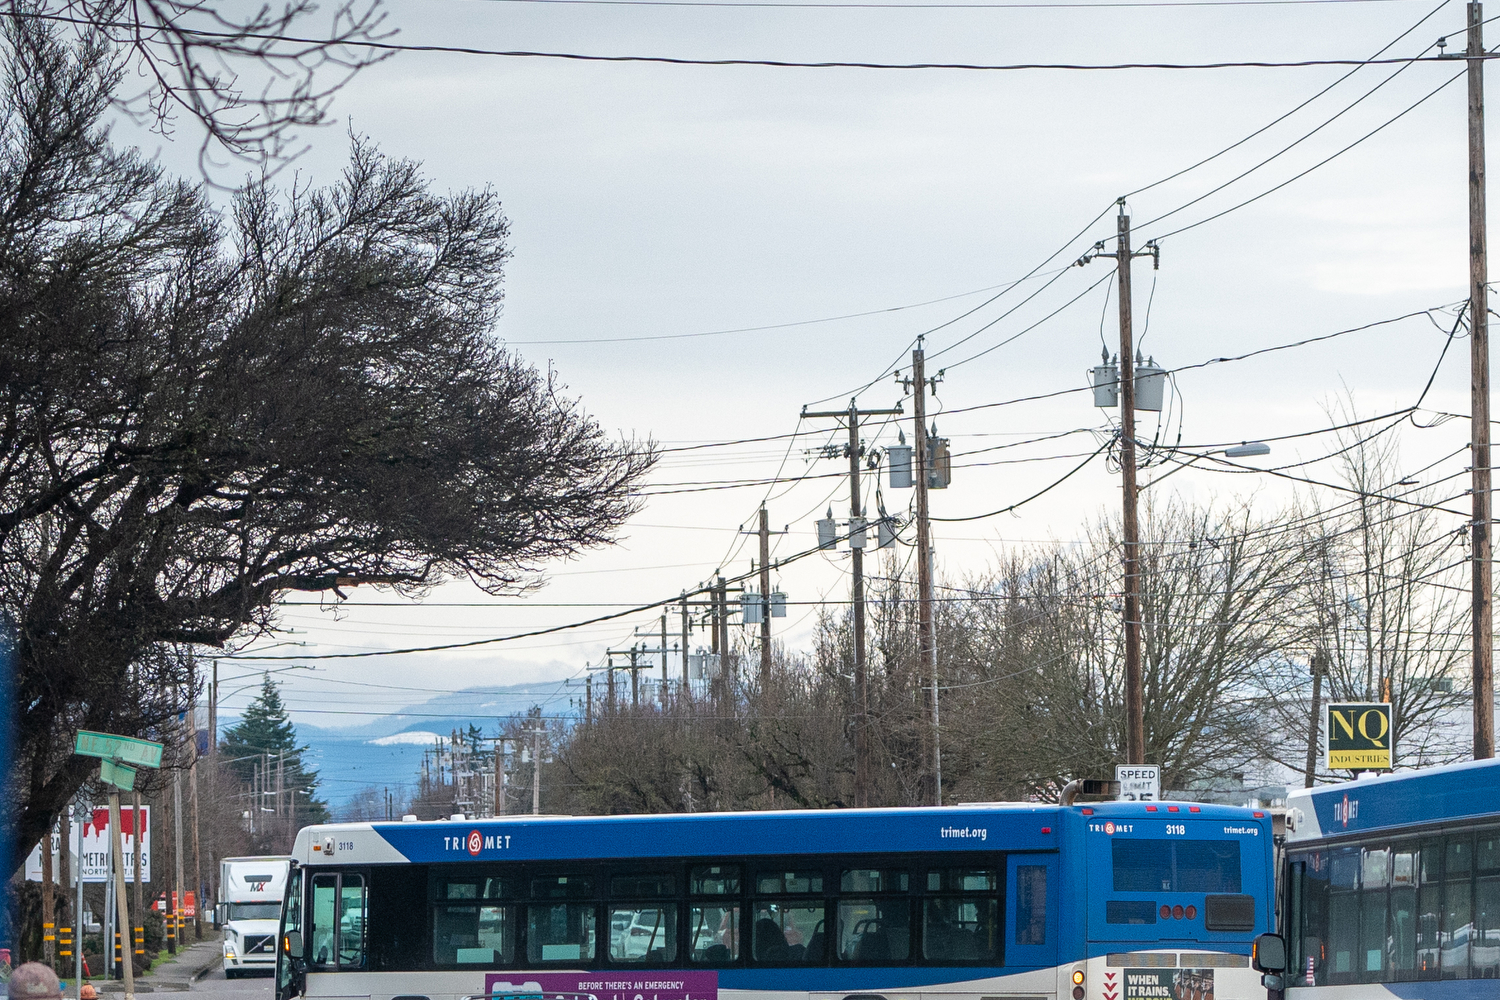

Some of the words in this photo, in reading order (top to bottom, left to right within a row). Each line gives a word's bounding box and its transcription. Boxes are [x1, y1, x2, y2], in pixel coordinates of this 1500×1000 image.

[1330, 709, 1389, 748] NQ
[81, 735, 99, 753] NE
[1330, 755, 1389, 763] INDUSTRIES
[1121, 771, 1155, 779] SPEED
[941, 826, 987, 840] trimet.org
[1166, 825, 1185, 835] 3118
[1224, 826, 1258, 836] trimet.org
[339, 841, 354, 851] 3118
[250, 882, 266, 892] MX
[1128, 975, 1159, 985] WHEN
[578, 981, 603, 990] BEFORE
[605, 981, 632, 990] THERE'S
[634, 981, 643, 990] AN
[645, 981, 684, 990] EMERGENCY
[1128, 986, 1138, 996] IT
[1138, 986, 1171, 997] RAINS,
